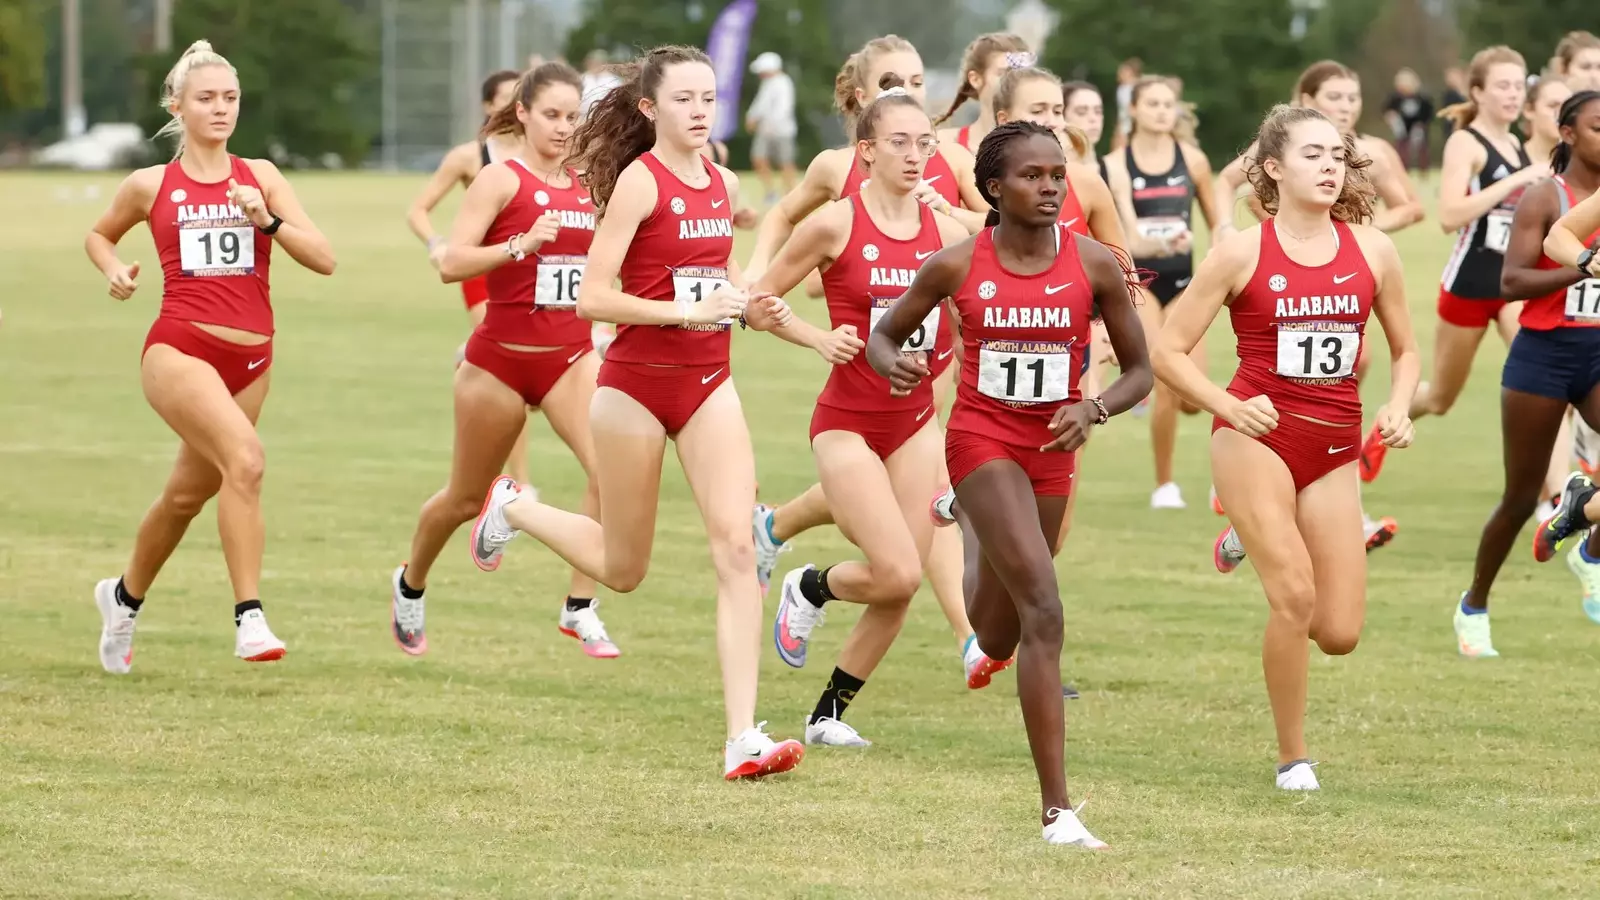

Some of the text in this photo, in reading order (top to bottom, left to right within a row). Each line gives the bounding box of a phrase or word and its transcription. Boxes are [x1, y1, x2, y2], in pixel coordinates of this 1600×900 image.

[177, 204, 247, 222] ALABAM
[198, 231, 240, 265] 19
[677, 267, 702, 277] NORTH
[553, 268, 582, 301] 16
[1275, 294, 1360, 318] ALABAMA
[1574, 281, 1600, 313] 17
[983, 307, 1071, 328] ALABAMA
[1283, 322, 1357, 332] NORTH ALABAMA
[986, 340, 1068, 353] NORTH ALABAMA
[1297, 335, 1343, 375] 13
[999, 356, 1045, 398] 11
